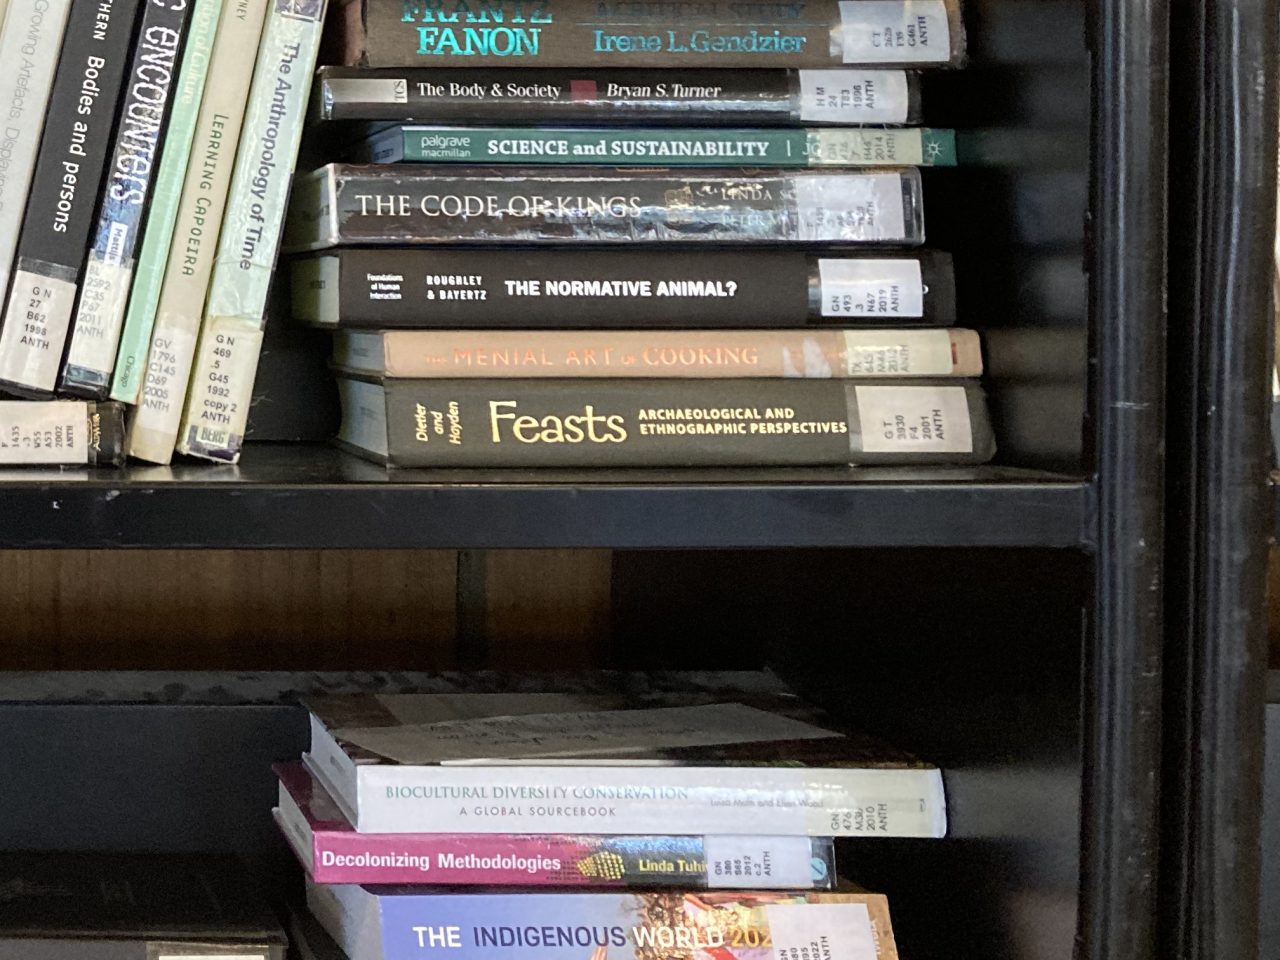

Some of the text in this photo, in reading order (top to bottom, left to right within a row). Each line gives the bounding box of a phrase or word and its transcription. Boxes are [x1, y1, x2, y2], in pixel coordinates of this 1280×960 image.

[415, 26, 542, 57] FANON
[592, 29, 808, 53] Irene Gendzier
[416, 82, 562, 100] The Body & Society
[606, 82, 722, 100] Bryan Turner
[53, 55, 106, 234] Bodies and persons
[421, 135, 471, 151] palgrave
[421, 149, 471, 159] macmillan
[487, 139, 770, 157] SCIENCE and SUSTAINABILITY
[239, 42, 301, 271] The Anthropology Time
[182, 112, 230, 277] LEARNING CAPOEIRA
[354, 194, 643, 219] THE CODE OF KINGS
[426, 275, 482, 286] ROUGHLEY
[504, 279, 739, 298] THE NORMATIVE ANIMAL?
[439, 289, 487, 301] BAYERTZ
[878, 289, 888, 313] 2019
[890, 284, 900, 313] ANTH
[19, 336, 50, 351] ANTH
[452, 347, 559, 368] MENIAL
[564, 346, 616, 368] ART
[642, 345, 759, 367] COOKING
[143, 399, 170, 411] ANTH
[203, 399, 229, 412] copy
[638, 407, 795, 421] ARCHAEOLOGICAL AND
[201, 410, 231, 425] ANTH
[415, 402, 429, 442] Dietler
[430, 410, 444, 435] and
[446, 400, 464, 446] Hayden
[488, 400, 628, 444] Feasts
[639, 421, 849, 436] ETHNOGRAPHIC PERSPECTIVES
[935, 408, 945, 440] ANTH
[385, 785, 690, 801] BIOCULTURAL DIVERSITY CONSERVATION
[458, 806, 617, 818] A GLOBAL SOURCEBOOK
[878, 802, 888, 832] ANTH
[321, 850, 562, 873] Decolonizing Methodologies
[638, 859, 675, 872] Linda
[762, 850, 771, 876] ANTH
[412, 925, 725, 949] THE INDIGENOUS WORLD
